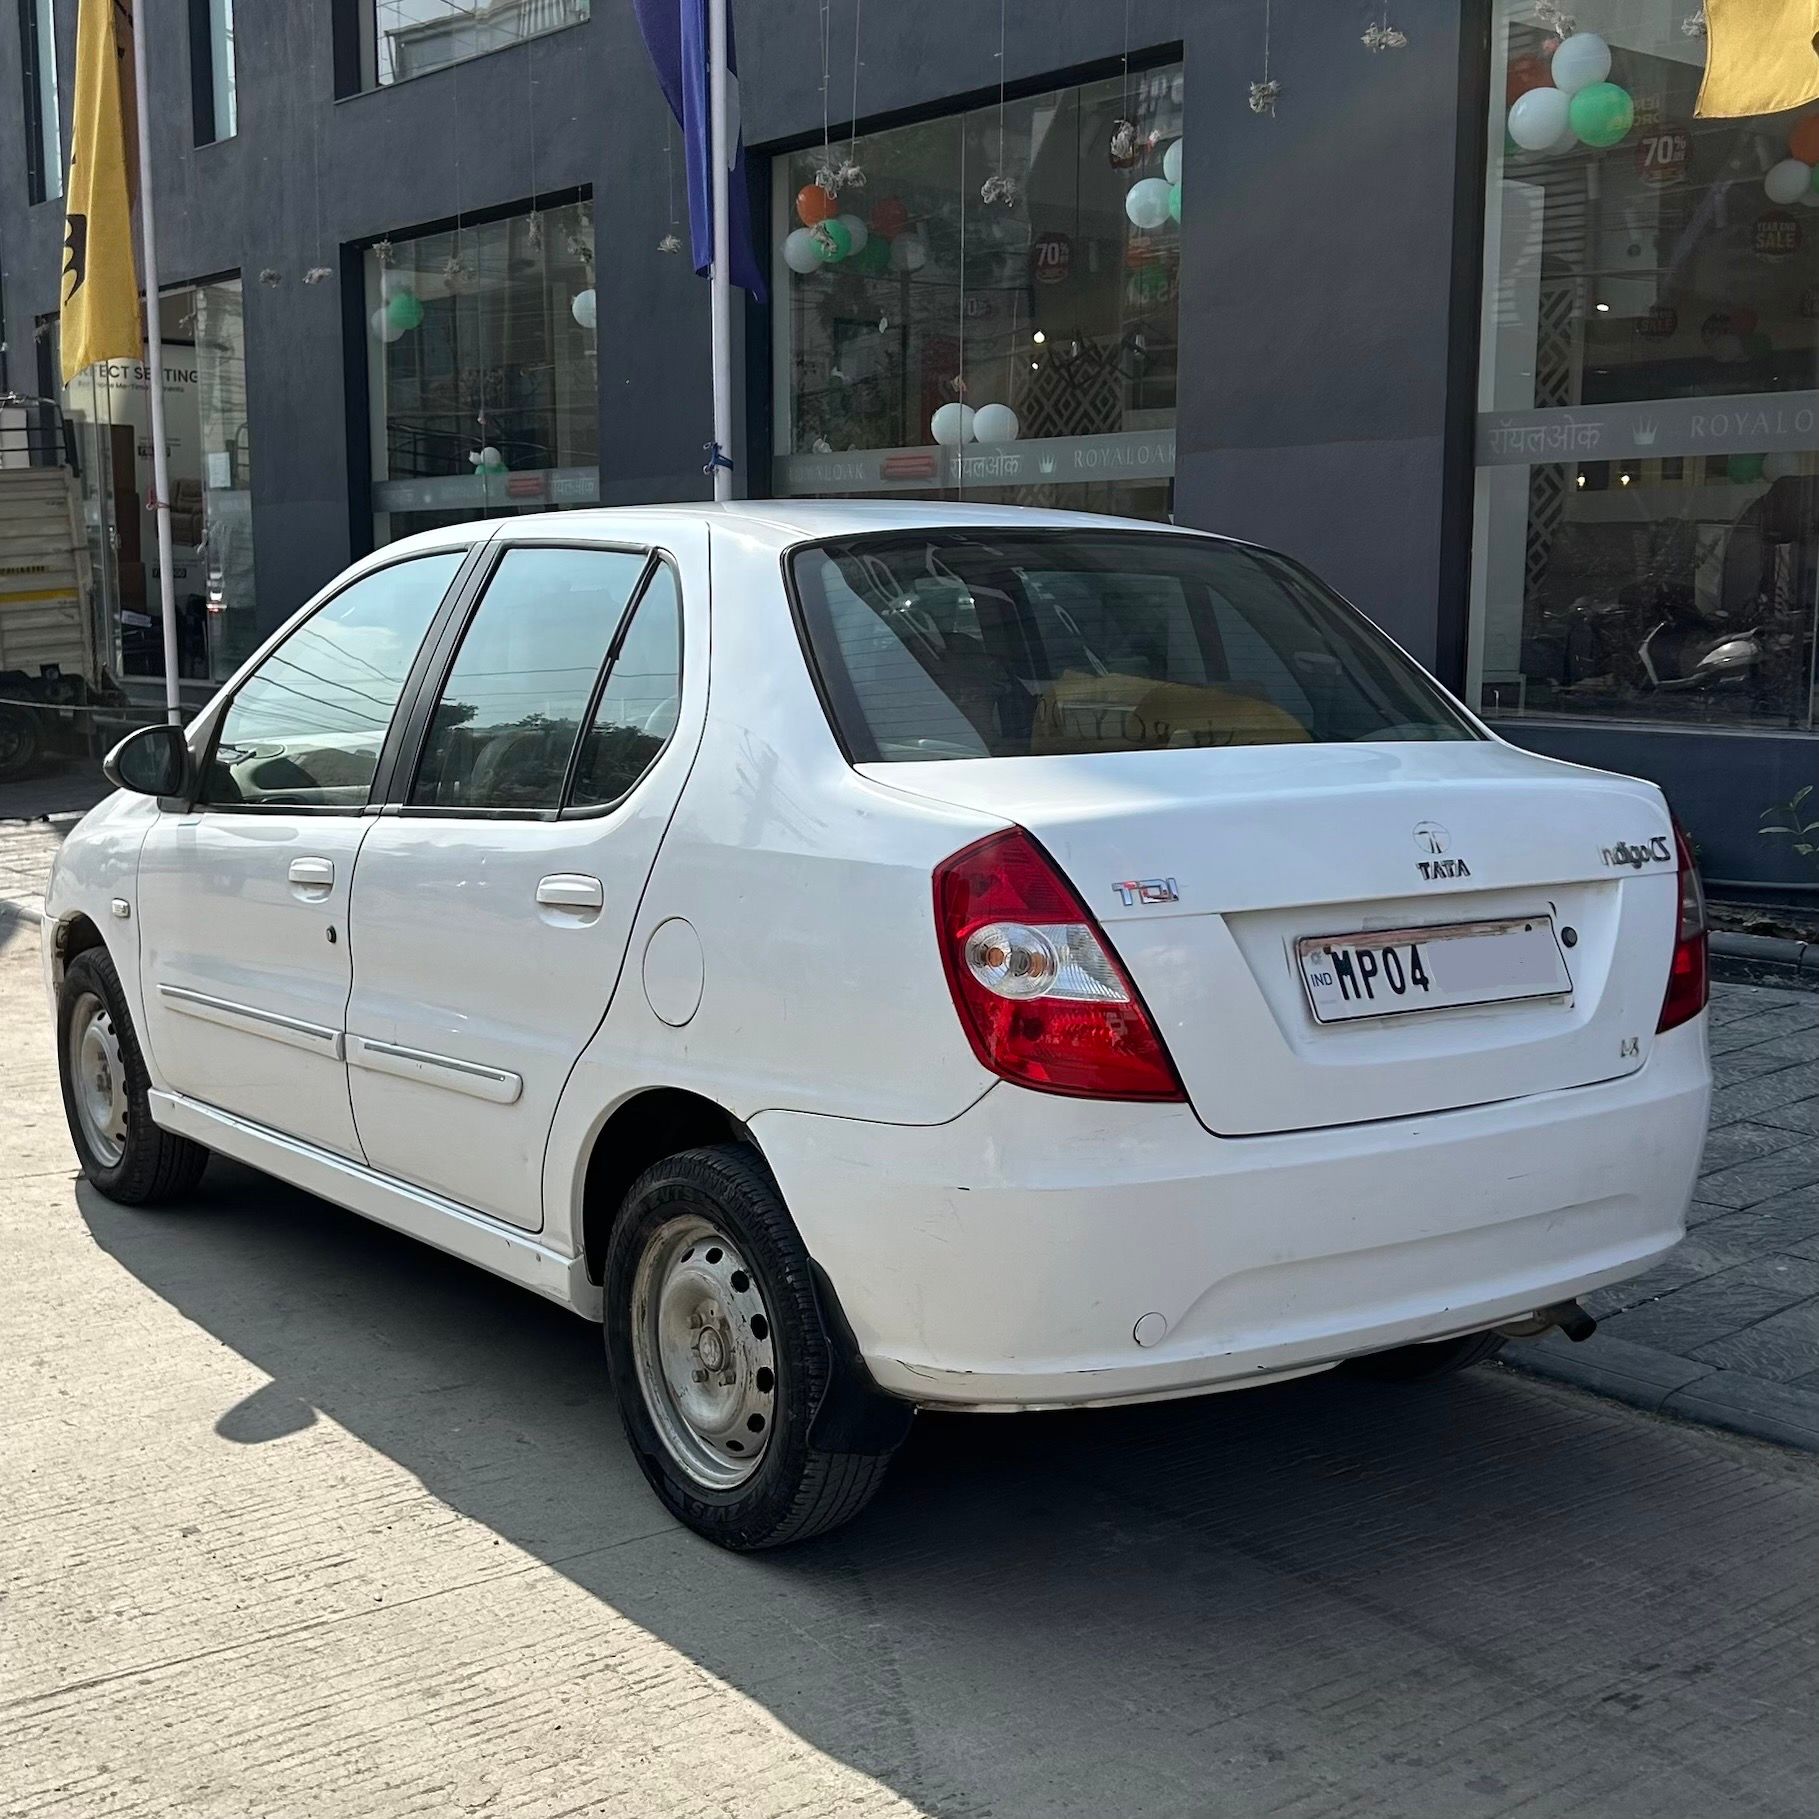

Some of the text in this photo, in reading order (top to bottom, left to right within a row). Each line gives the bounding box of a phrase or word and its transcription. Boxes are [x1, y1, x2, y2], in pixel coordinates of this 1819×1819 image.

[1756, 231, 1796, 249] SALE
[134, 366, 199, 384] SETING
[1416, 859, 1471, 880] TATA
[1112, 878, 1179, 906] TDI
[1310, 972, 1333, 988] IND
